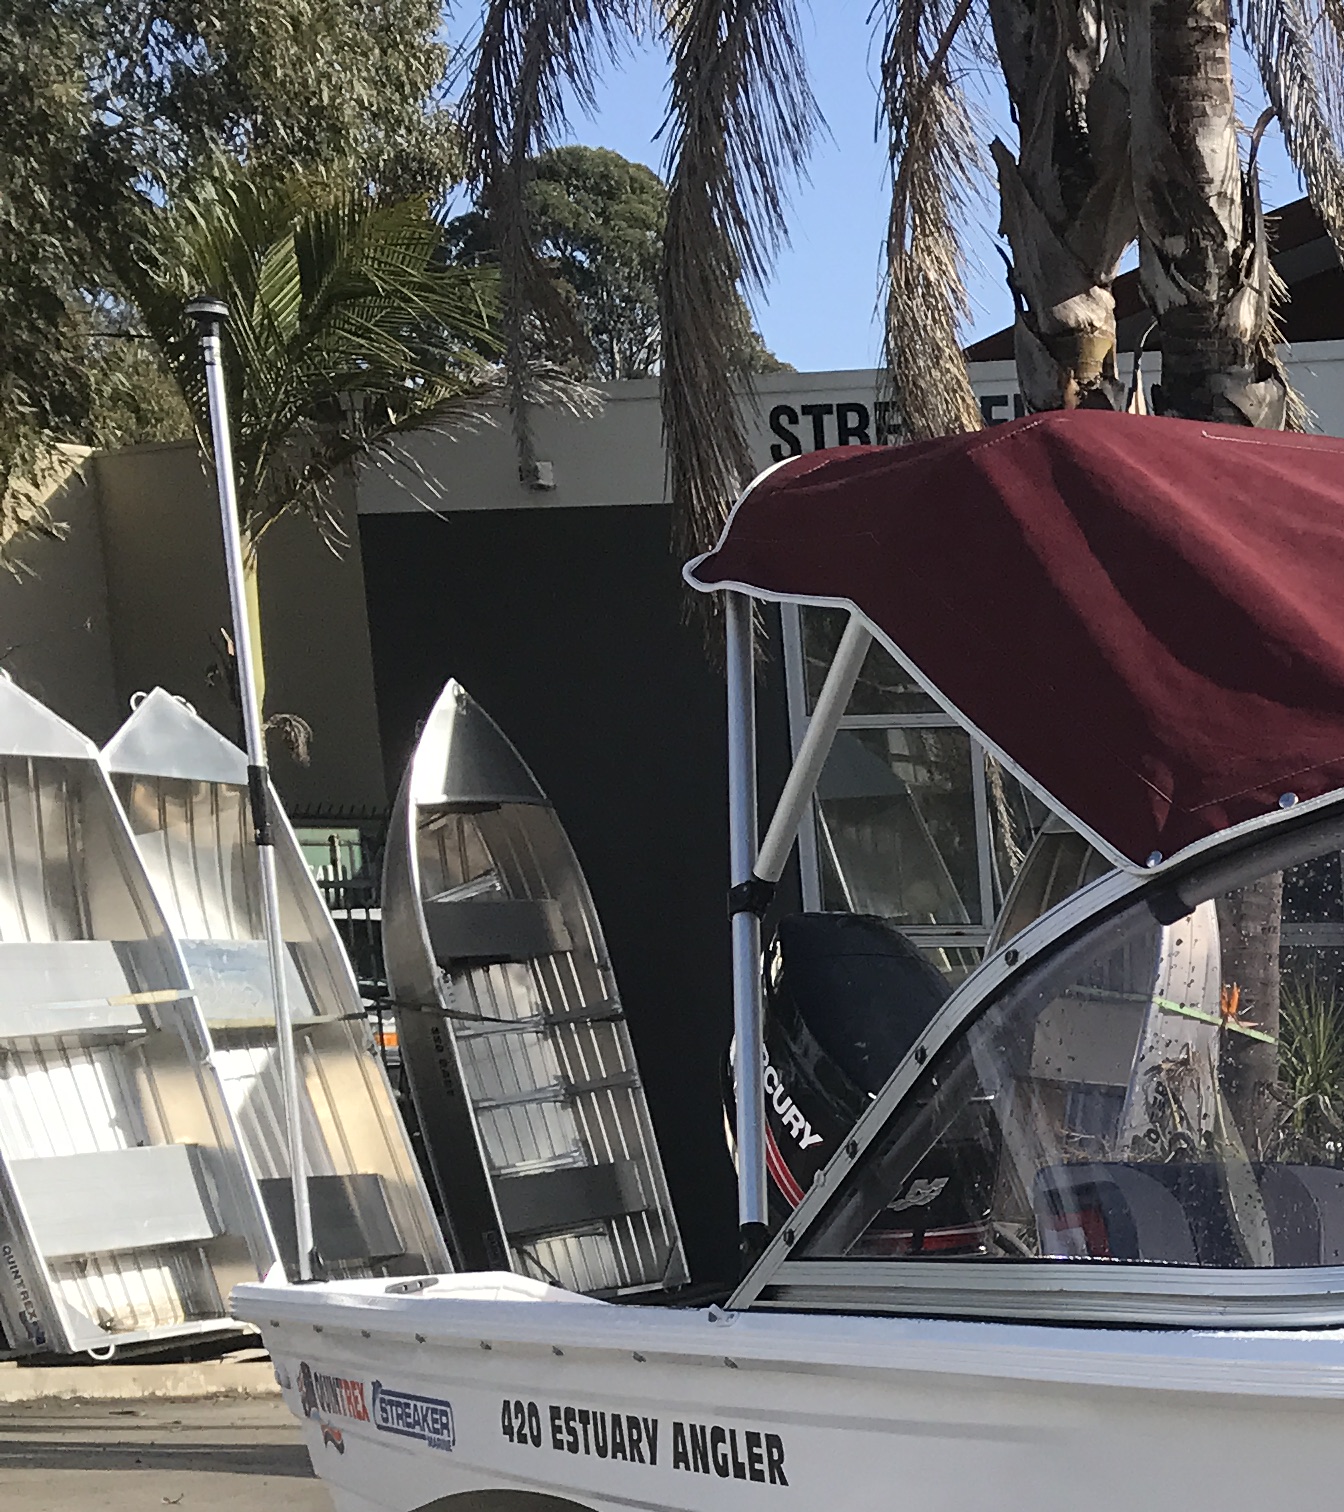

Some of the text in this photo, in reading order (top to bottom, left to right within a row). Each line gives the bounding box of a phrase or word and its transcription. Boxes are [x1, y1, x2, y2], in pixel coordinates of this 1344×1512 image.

[314, 1372, 370, 1423] QUINTREX
[379, 1397, 451, 1438] STREAKER
[501, 1398, 790, 1487] 420 ESTUARY ANGLER
